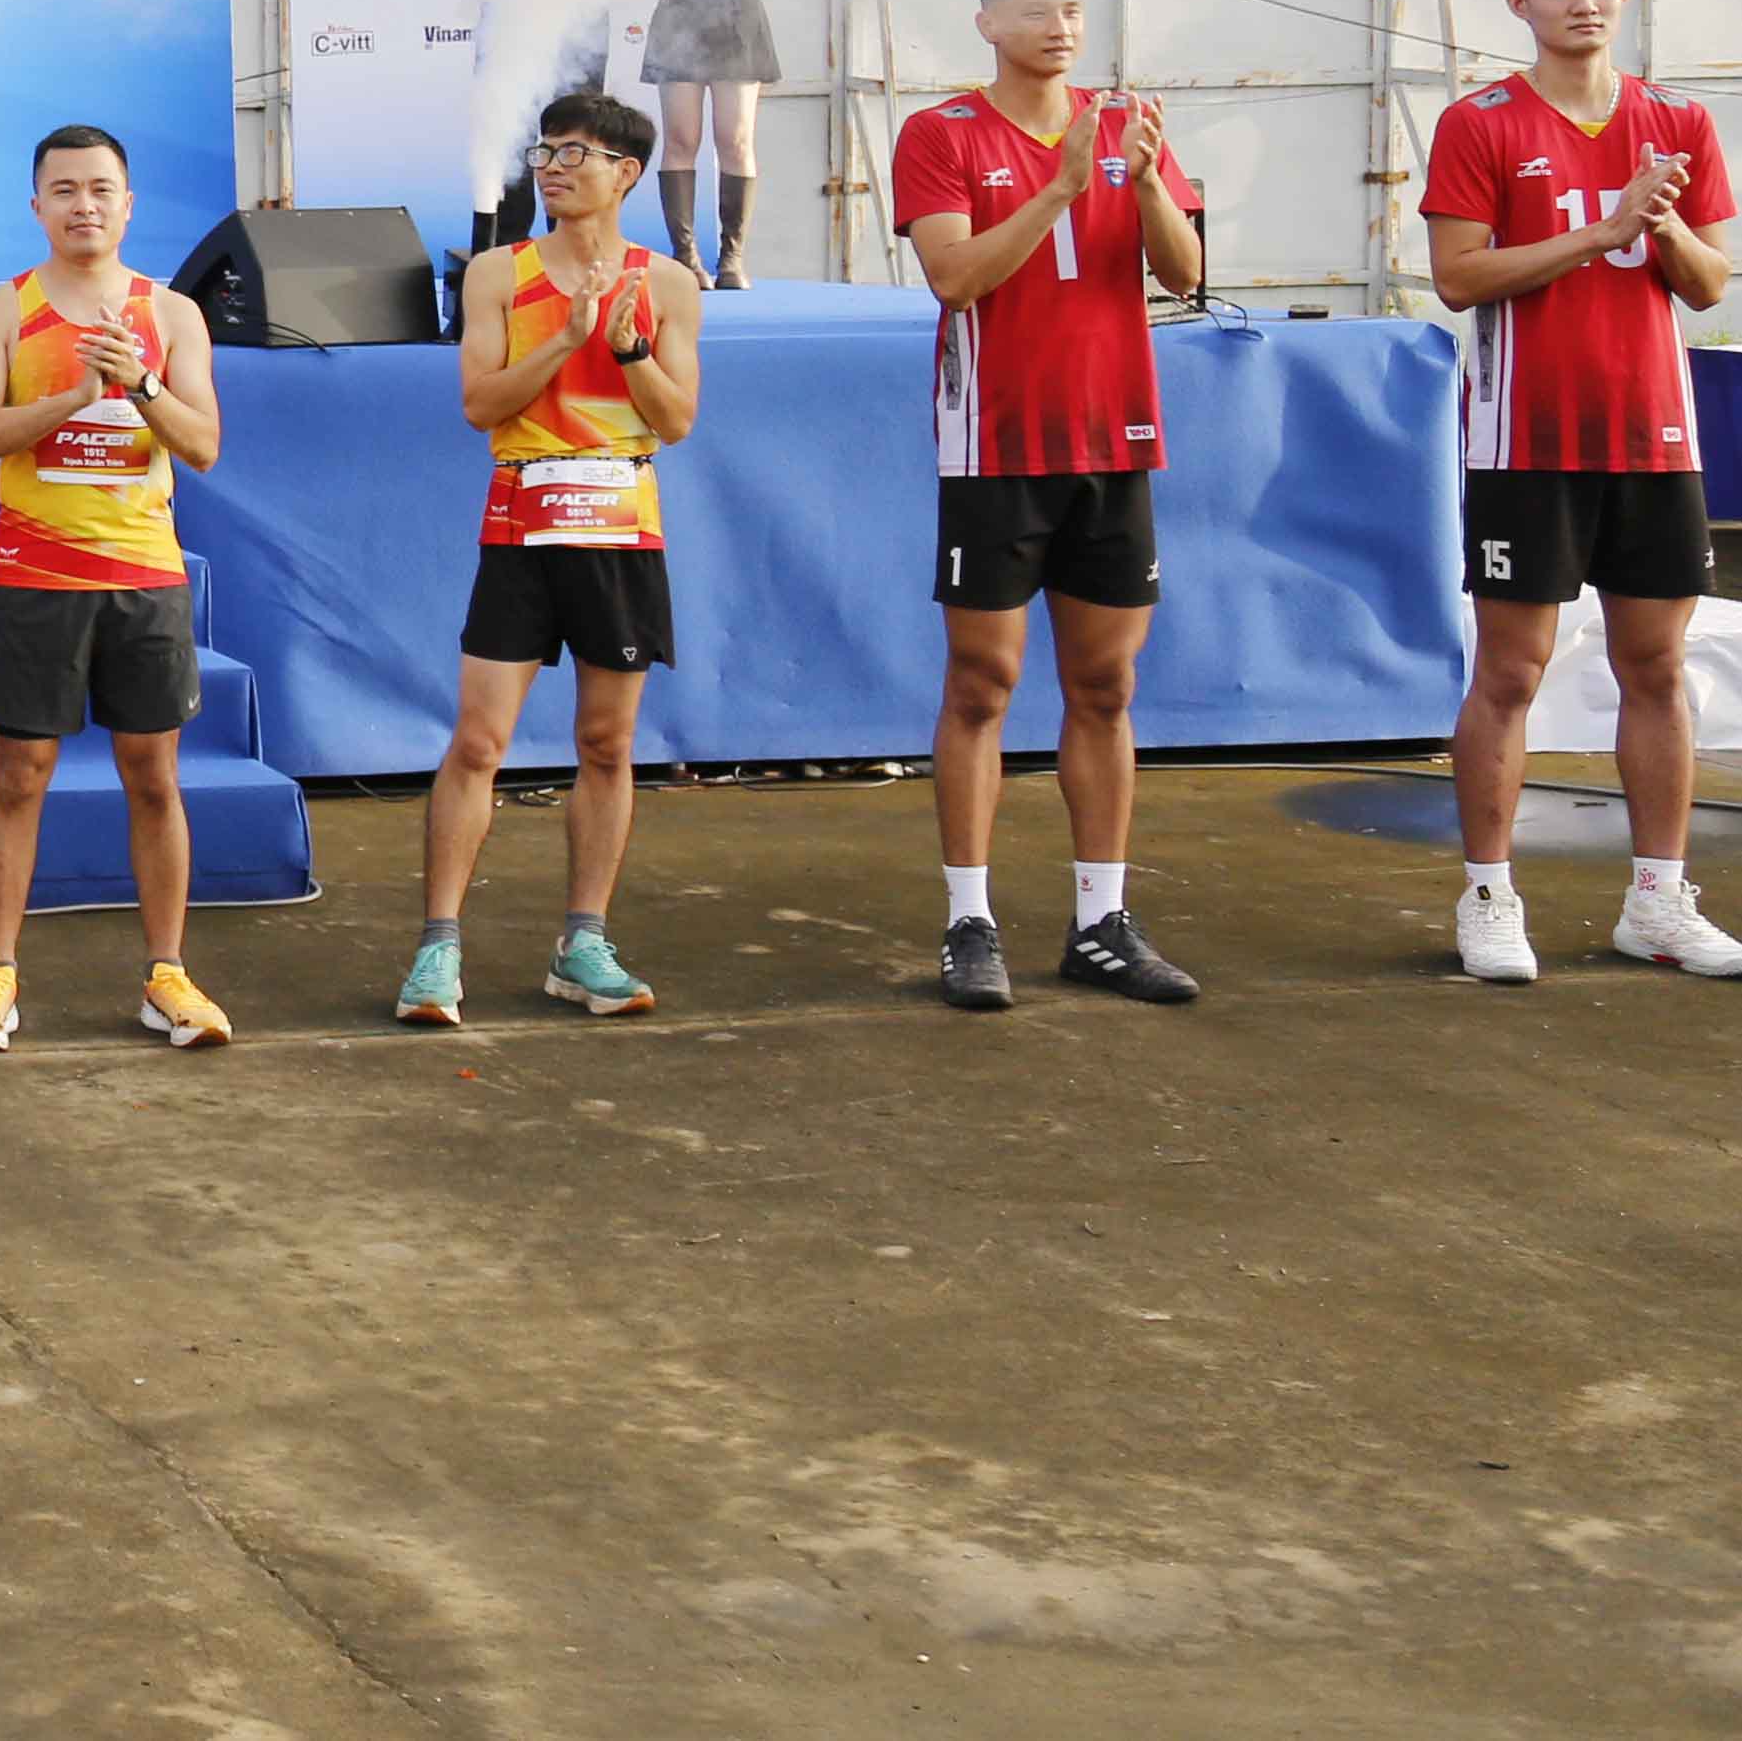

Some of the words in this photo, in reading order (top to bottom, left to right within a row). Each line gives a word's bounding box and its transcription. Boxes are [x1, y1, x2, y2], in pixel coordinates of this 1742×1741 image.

[314, 33, 374, 53] C-vitt
[55, 431, 134, 447] PACER
[540, 492, 620, 508] PACER
[949, 547, 963, 587] 1
[1480, 540, 1512, 581] 15
